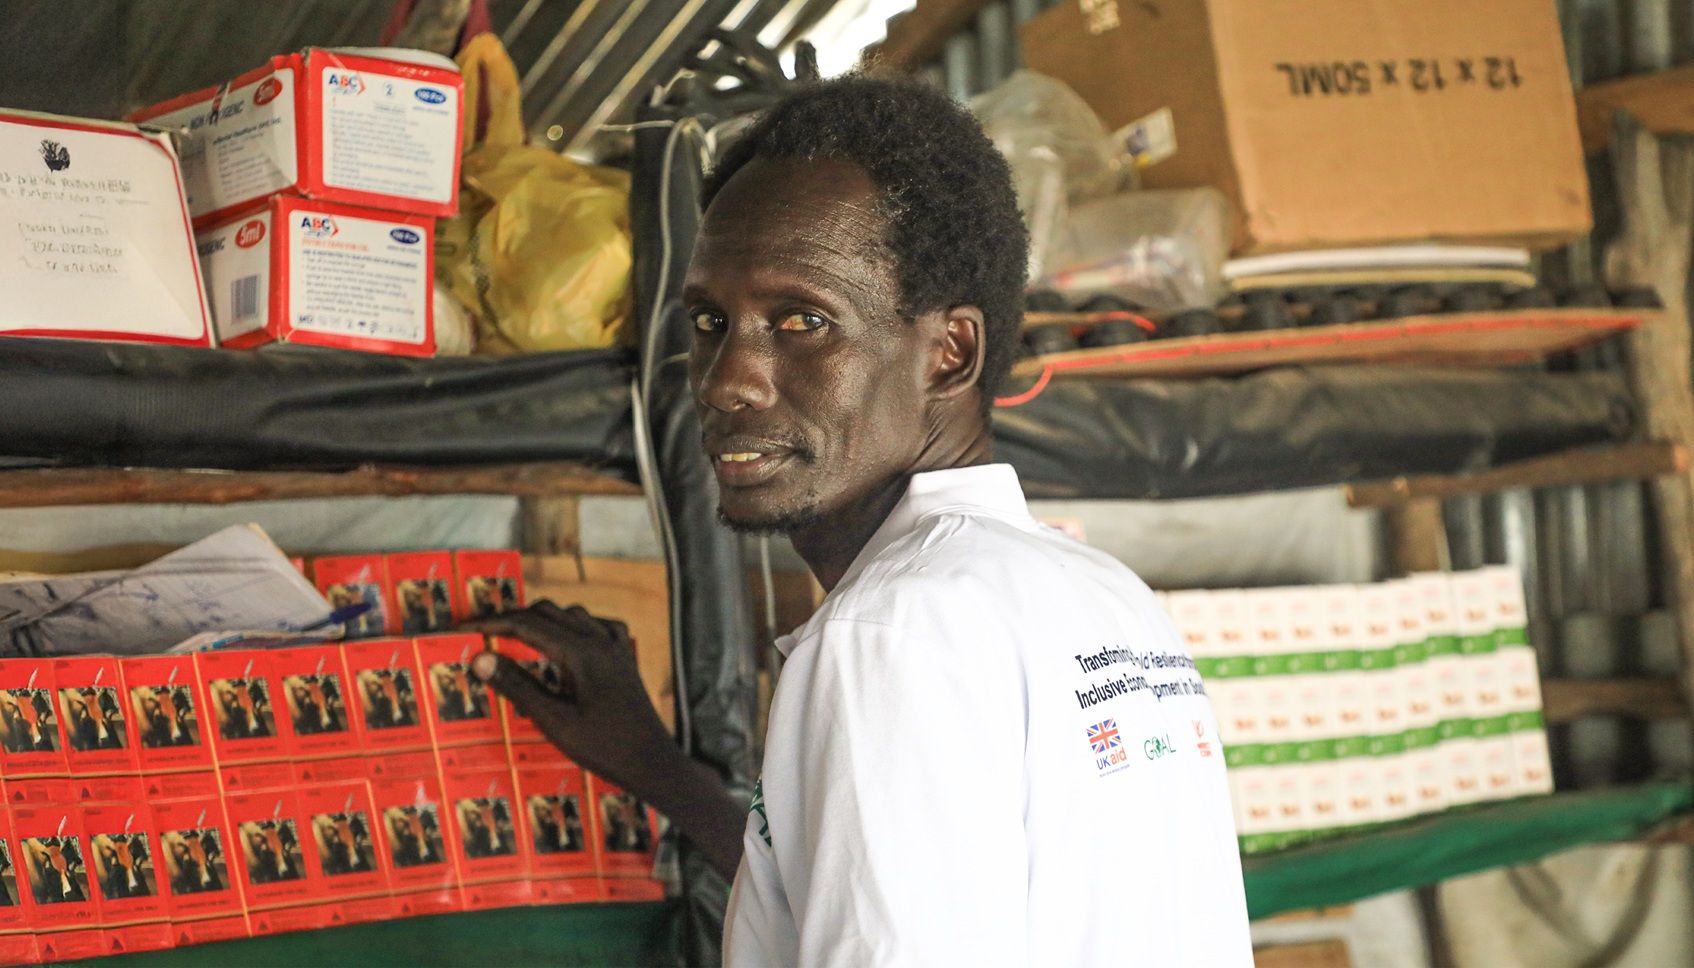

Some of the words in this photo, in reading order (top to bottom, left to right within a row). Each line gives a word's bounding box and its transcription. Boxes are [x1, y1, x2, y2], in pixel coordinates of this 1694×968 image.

[1276, 62, 1372, 97] 50ML
[1409, 60, 1446, 94] 12
[1485, 57, 1523, 92] 12
[301, 216, 332, 231] ABC
[1075, 678, 1128, 710] Inclusive
